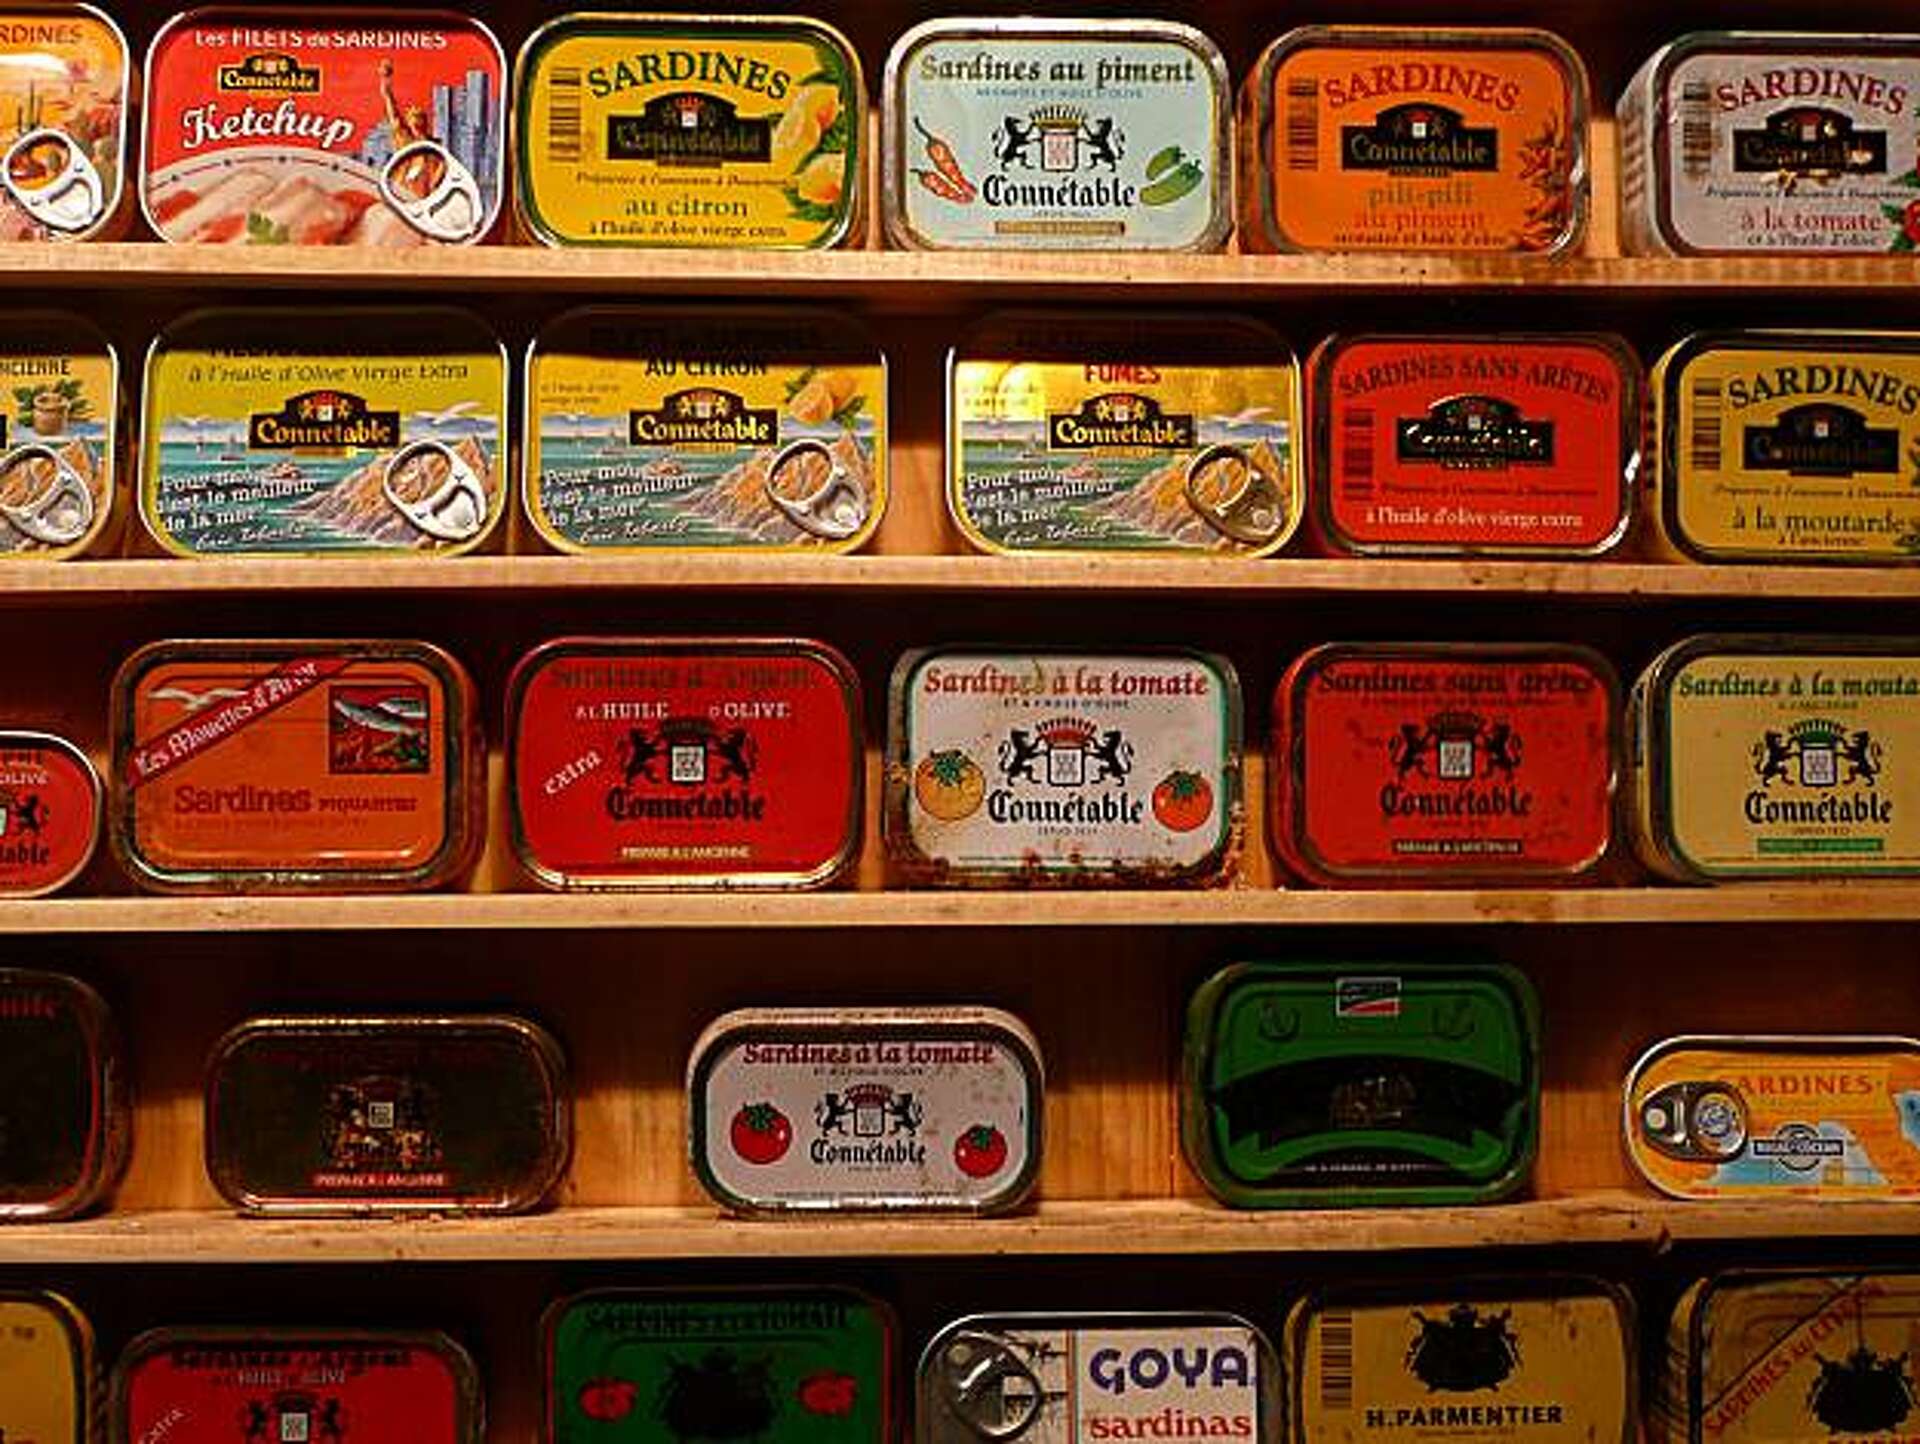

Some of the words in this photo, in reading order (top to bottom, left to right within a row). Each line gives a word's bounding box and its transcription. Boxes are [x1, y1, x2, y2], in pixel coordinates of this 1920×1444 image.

[232, 31, 302, 48] FILETS
[331, 31, 448, 48] SARDINES
[588, 50, 792, 100] SARDINES
[919, 53, 1040, 82] Sardines
[1050, 58, 1084, 82] au
[1096, 55, 1196, 89] piment
[1324, 64, 1520, 112] SARDINES
[1715, 67, 1908, 115] SARDINES
[183, 98, 355, 150] Ketchup
[625, 198, 657, 217] au
[667, 192, 748, 217] citron
[982, 174, 1136, 207] Connétable
[1740, 209, 1756, 231] à
[1793, 211, 1883, 232] tomate
[352, 364, 413, 383] Vierge
[418, 363, 469, 380] Extra
[1338, 356, 1455, 396] SARDINES
[1459, 353, 1520, 379] SANS
[1727, 364, 1920, 416] SARDINES
[636, 414, 770, 441] Connétable
[1056, 420, 1189, 447] Connétable
[1379, 506, 1430, 524] l'huile
[1433, 506, 1486, 526] d'olive
[1489, 509, 1539, 528] vierge
[1541, 511, 1584, 527] extra
[1732, 504, 1747, 529] à
[1756, 504, 1777, 529] la
[1052, 666, 1070, 696] à
[1075, 664, 1106, 696] la
[1110, 664, 1210, 697] tomate
[1678, 672, 1781, 698] Sardines
[1789, 672, 1804, 696] à
[1811, 669, 1836, 696] la
[135, 750, 171, 775] Les
[167, 701, 253, 757] Mouettes
[543, 749, 602, 796] extra
[174, 784, 312, 816] Sardines
[987, 789, 1145, 825] Connétable
[1744, 789, 1894, 825] Connétable
[742, 1042, 850, 1065] Sardines
[907, 1042, 996, 1065] tomate
[1738, 1074, 1873, 1095] ARDINES
[810, 1138, 927, 1166] Connétable
[1089, 1346, 1250, 1395] GOYA
[1089, 1408, 1252, 1440] sardinas
[1366, 1405, 1564, 1429] H.PARMENTIER
